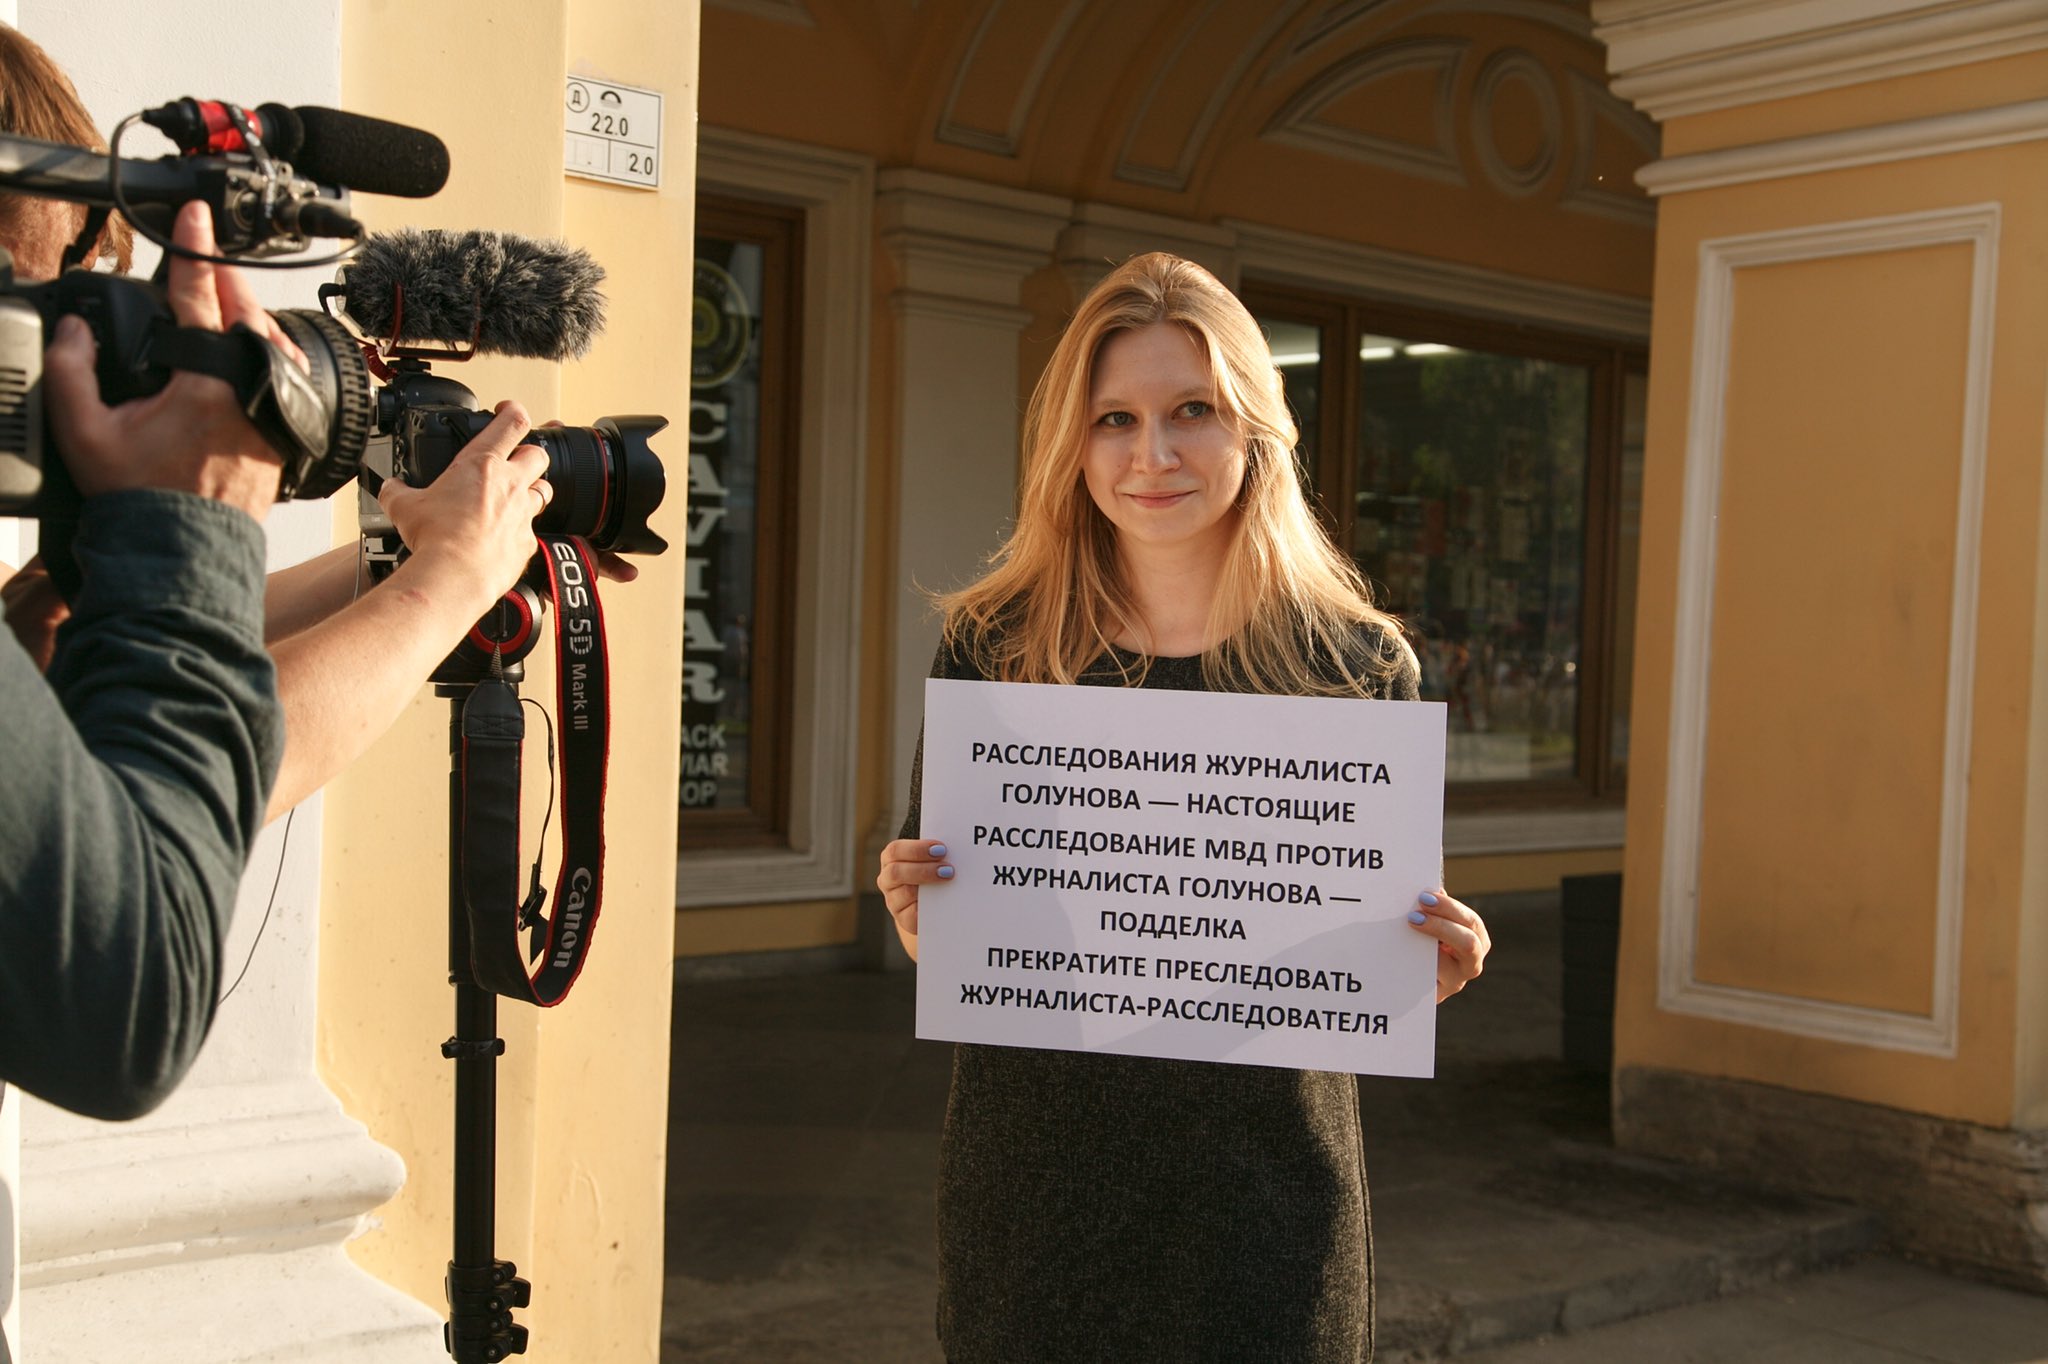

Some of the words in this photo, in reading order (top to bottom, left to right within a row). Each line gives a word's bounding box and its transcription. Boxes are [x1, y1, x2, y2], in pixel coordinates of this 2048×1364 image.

[591, 112, 629, 136] 22.0
[629, 153, 654, 175] 2.0
[552, 541, 589, 608] EOS
[568, 618, 593, 655] 5D
[571, 663, 588, 711] Mark
[682, 724, 728, 749] ACK
[972, 742, 1196, 774] РАССЛЕДОВАНИЯ
[1205, 754, 1391, 785] ЖУРНАЛИСТА
[681, 781, 718, 805] OP
[1002, 783, 1141, 810] ГОЛУНОВА
[1187, 793, 1356, 825] НАСТОЯЩИЕ
[973, 825, 1196, 858] РАССЛЕДОВАНИЕ
[1205, 839, 1267, 868] МВД
[1276, 843, 1384, 870] ПРОТИВ
[992, 865, 1171, 896] ЖУРНАЛИСТА
[1179, 877, 1322, 906] ГОЛУНОВА
[553, 867, 592, 968] Canon
[1100, 910, 1247, 940] ПОДДЕЛКА
[987, 947, 1147, 977] ПРЕКРАТИТЕ
[1155, 958, 1363, 993] ПРЕСЛЕДОВАТЬ
[960, 984, 1388, 1035] ЖУРНАЛИСТА-РАССЛЕДОВАТЕЛЯ
